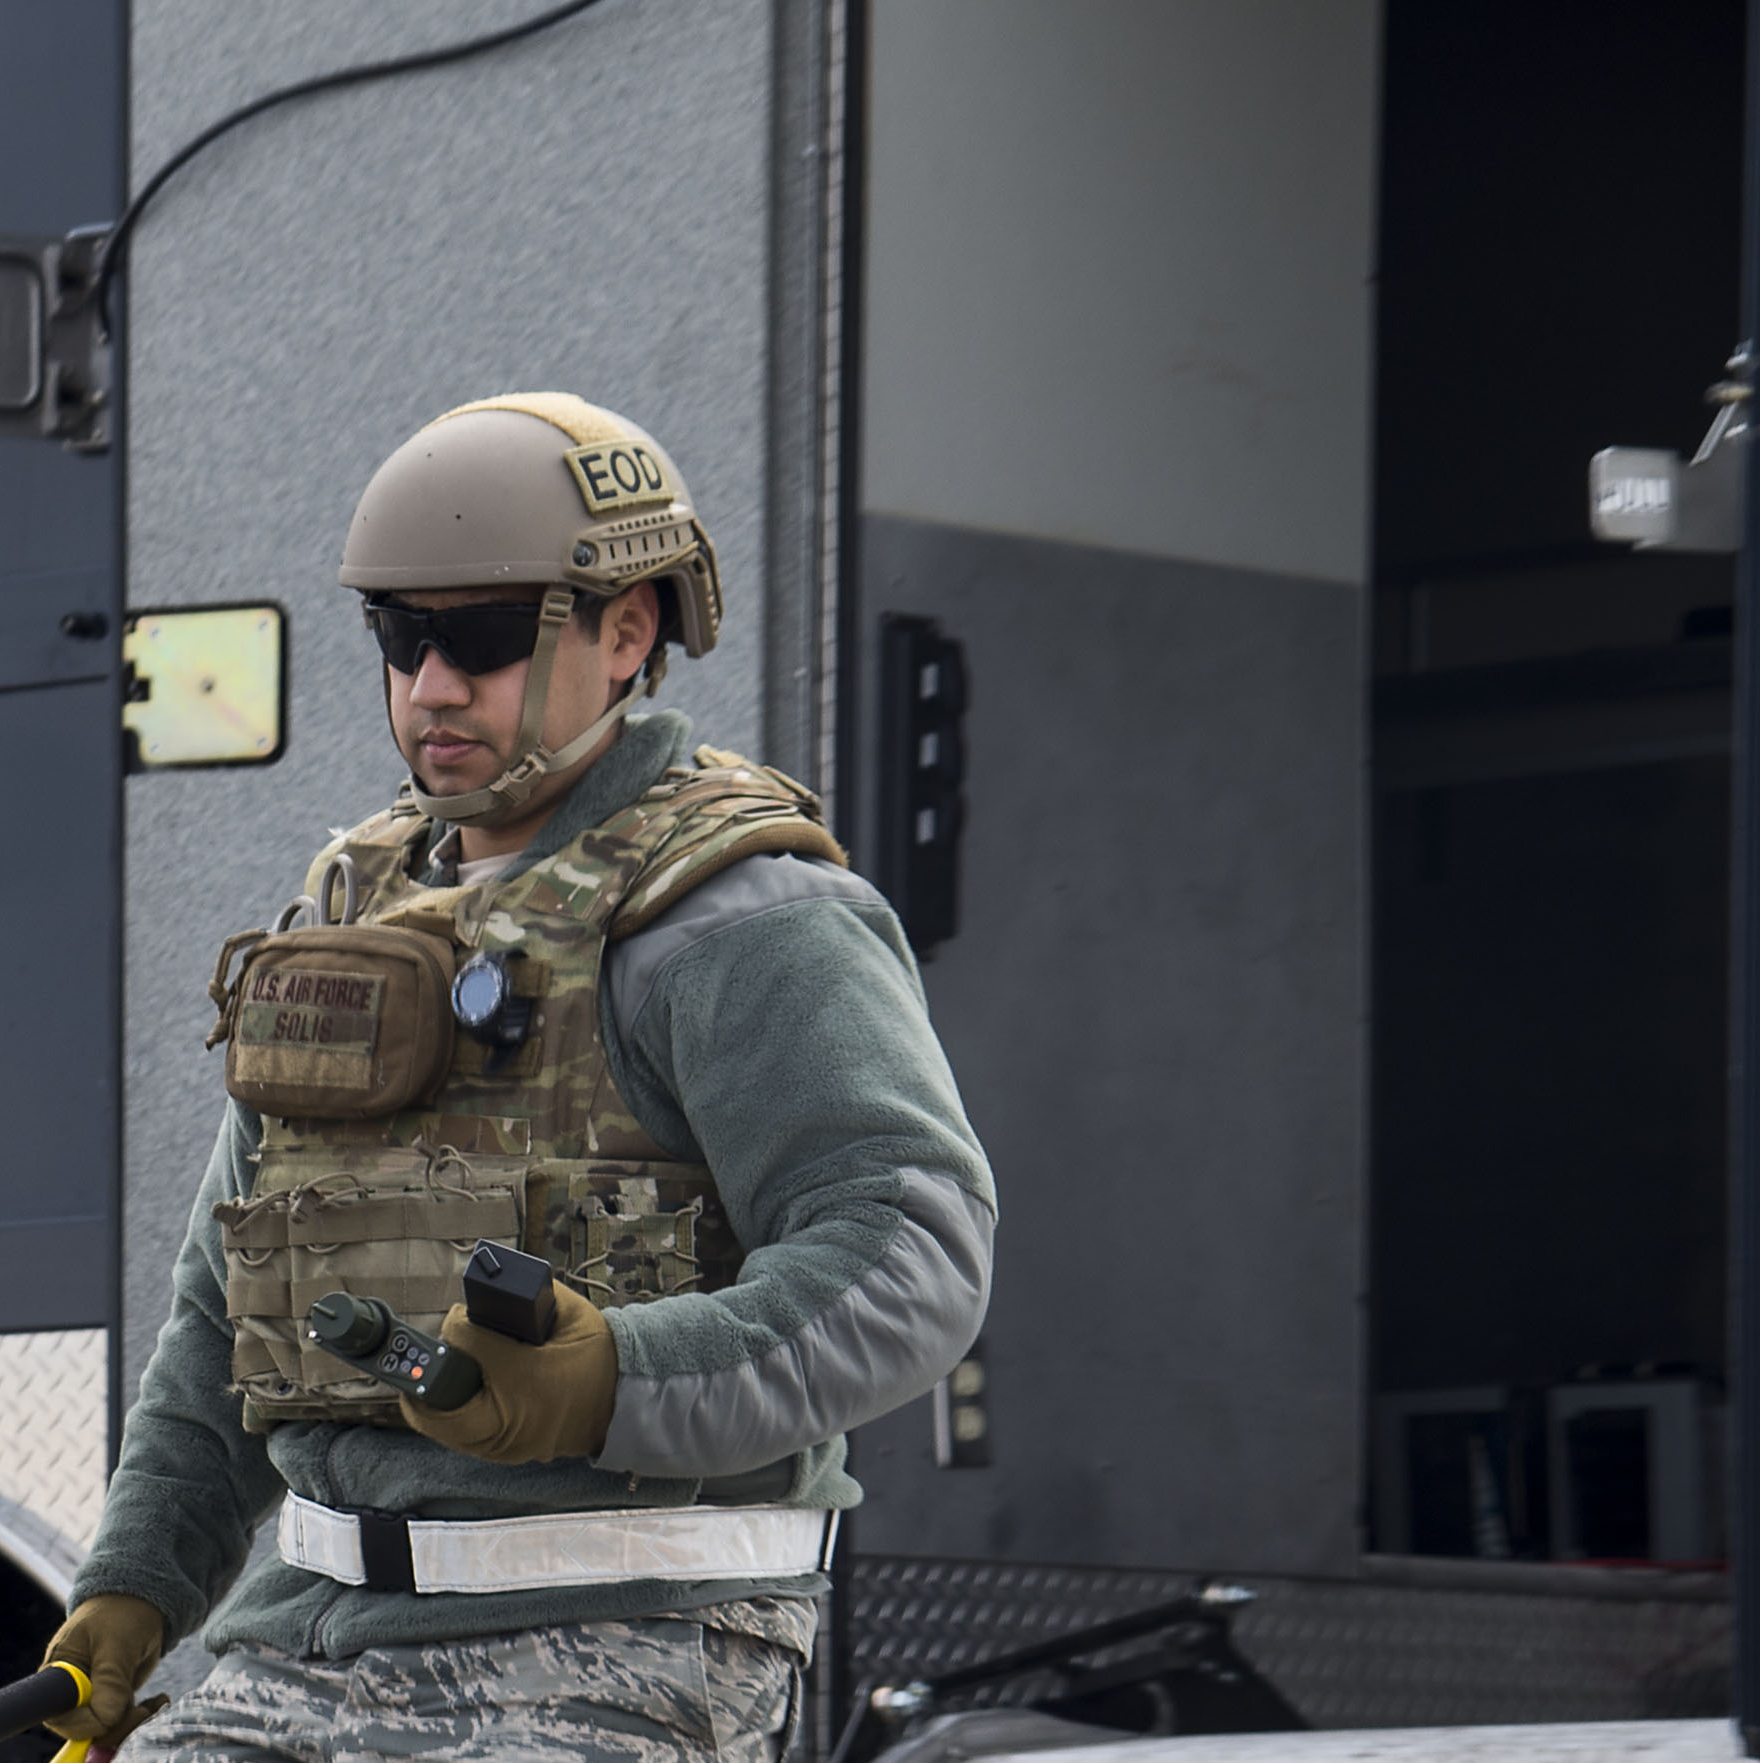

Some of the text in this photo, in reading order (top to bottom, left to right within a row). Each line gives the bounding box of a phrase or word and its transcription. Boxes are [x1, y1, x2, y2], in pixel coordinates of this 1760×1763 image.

[579, 446, 662, 501] EOD
[284, 975, 312, 1004] AIR
[314, 976, 375, 1011] FORCE
[274, 1012, 333, 1043] SOLIS
